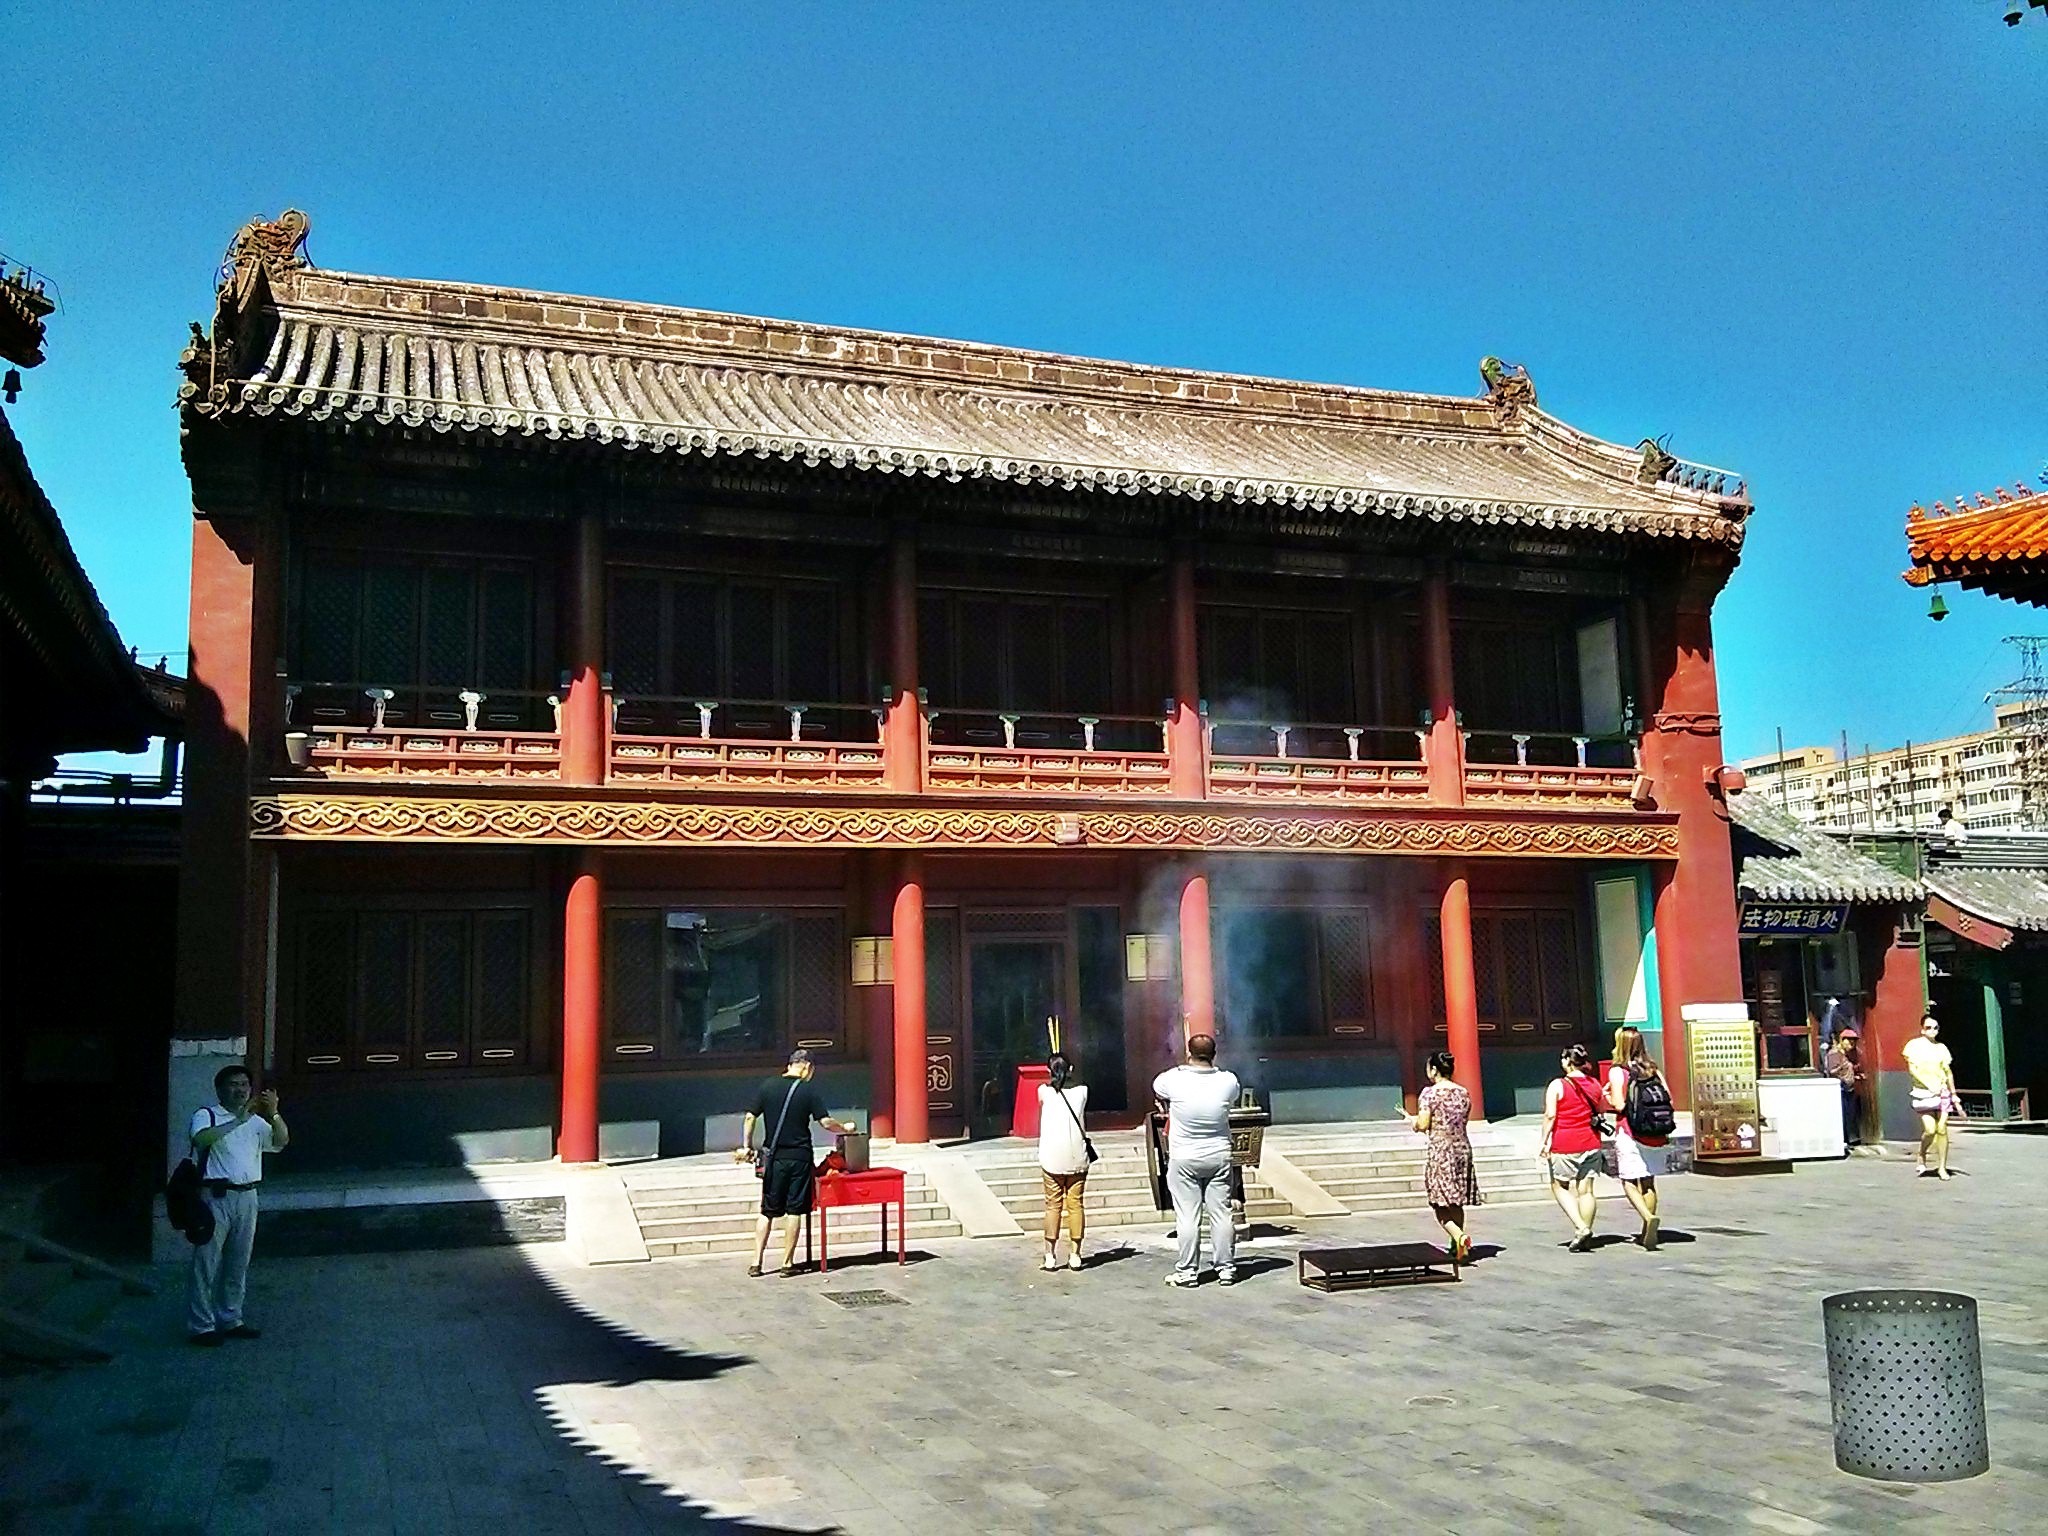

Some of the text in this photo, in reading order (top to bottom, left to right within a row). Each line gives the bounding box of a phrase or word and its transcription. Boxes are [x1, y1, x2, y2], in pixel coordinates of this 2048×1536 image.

[1742, 908, 1839, 929] 法物流通处
